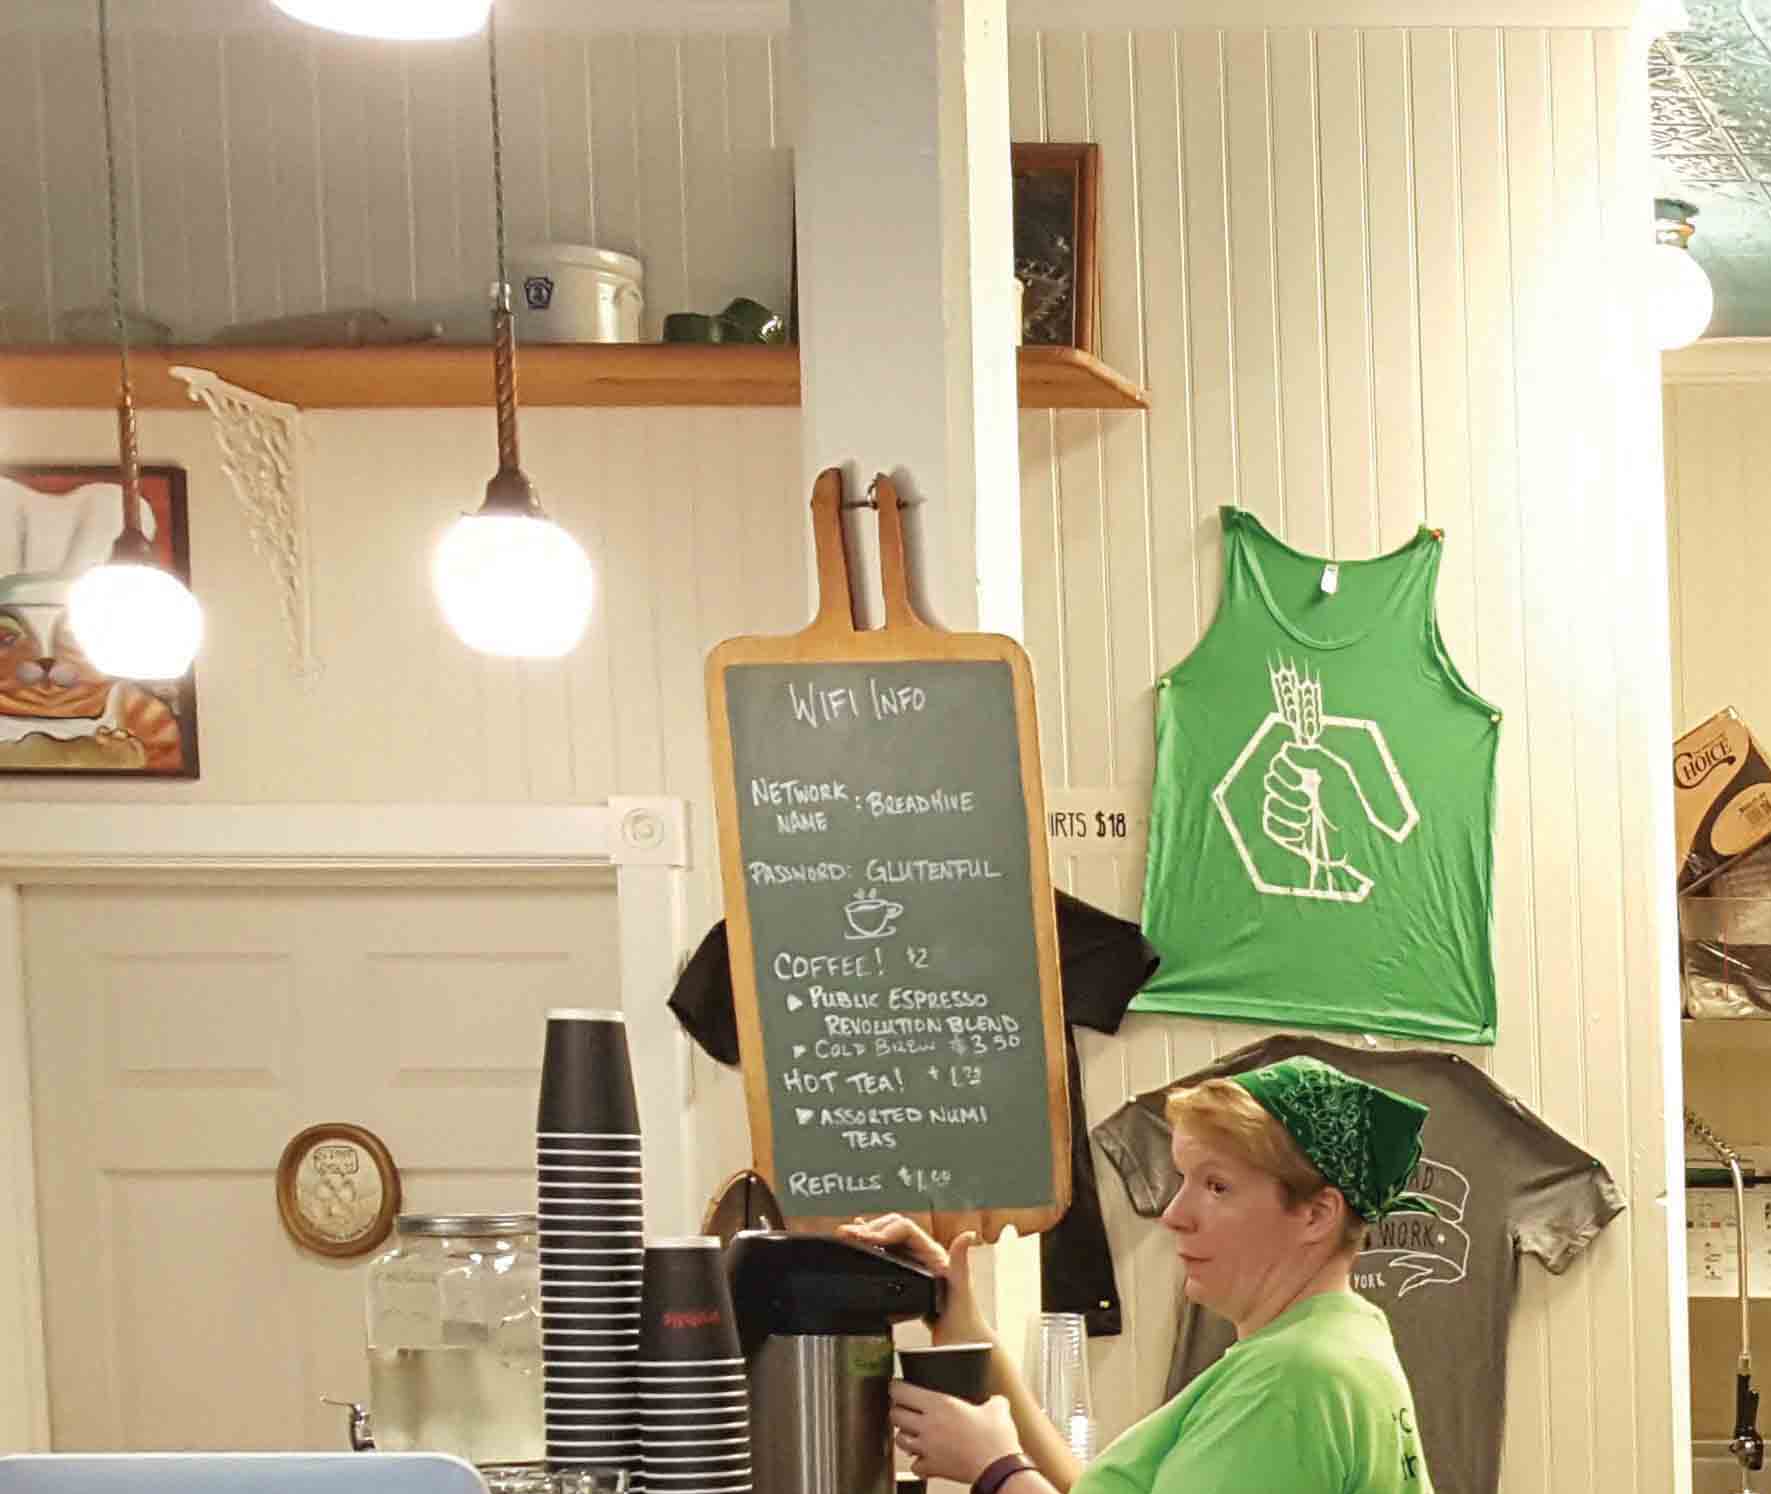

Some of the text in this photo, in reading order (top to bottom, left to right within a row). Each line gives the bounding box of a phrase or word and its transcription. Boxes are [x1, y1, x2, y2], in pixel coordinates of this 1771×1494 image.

[789, 679, 927, 728] WIFI INFO
[751, 779, 849, 807] NETWORK
[777, 812, 828, 834] NAME
[1050, 811, 1127, 838] IRTS $18
[866, 857, 1002, 883] GLUTENFUL
[888, 988, 990, 1010] ESPRESSO
[824, 1013, 1020, 1038] REVOLUTION BLEND
[784, 1069, 840, 1095] HOT
[819, 1104, 989, 1129] ASSORTED NUMI
[842, 1130, 897, 1150] TEAS
[788, 1171, 883, 1197] REFILLS
[1378, 1219, 1436, 1249] WORK
[1354, 1272, 1387, 1290] YORK
